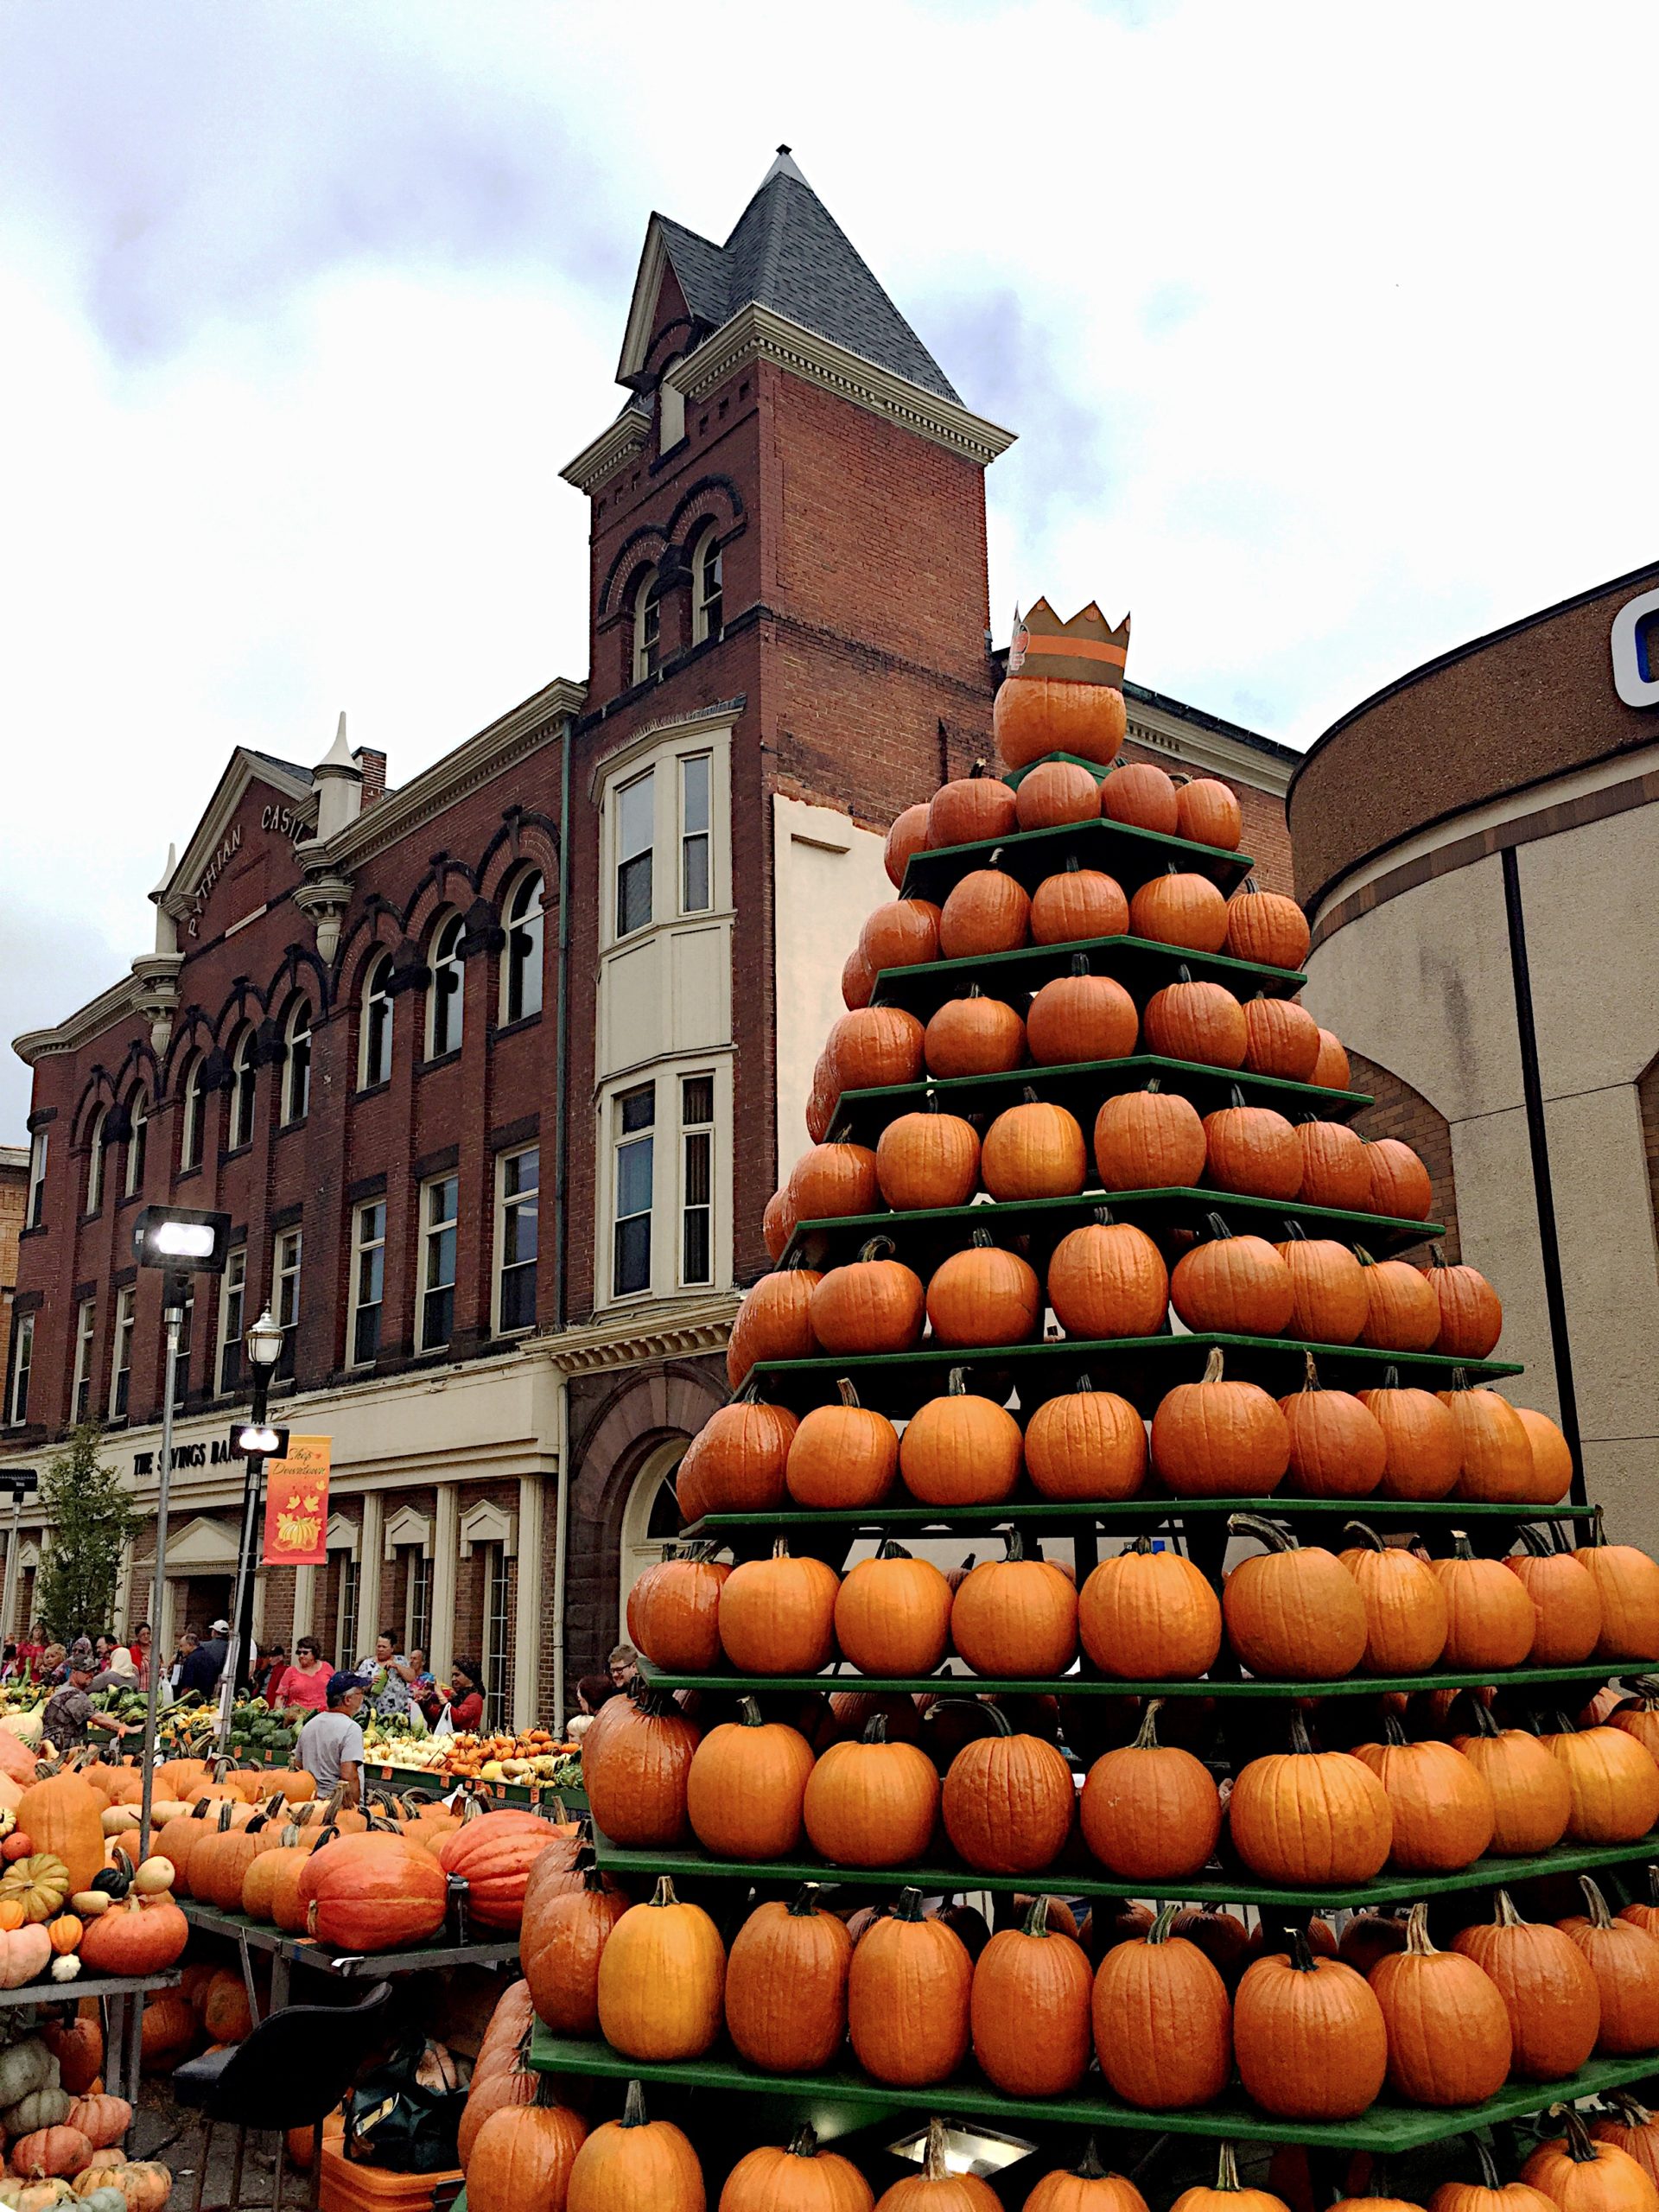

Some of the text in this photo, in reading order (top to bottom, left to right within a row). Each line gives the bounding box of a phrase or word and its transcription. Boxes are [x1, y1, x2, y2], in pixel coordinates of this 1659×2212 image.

[188, 804, 304, 938] PYTHIAN CASTL
[133, 1452, 155, 1476] THE
[156, 1442, 207, 1471] SVINGS
[272, 1462, 326, 1475] Downtown
[288, 1447, 314, 1465] Shop
